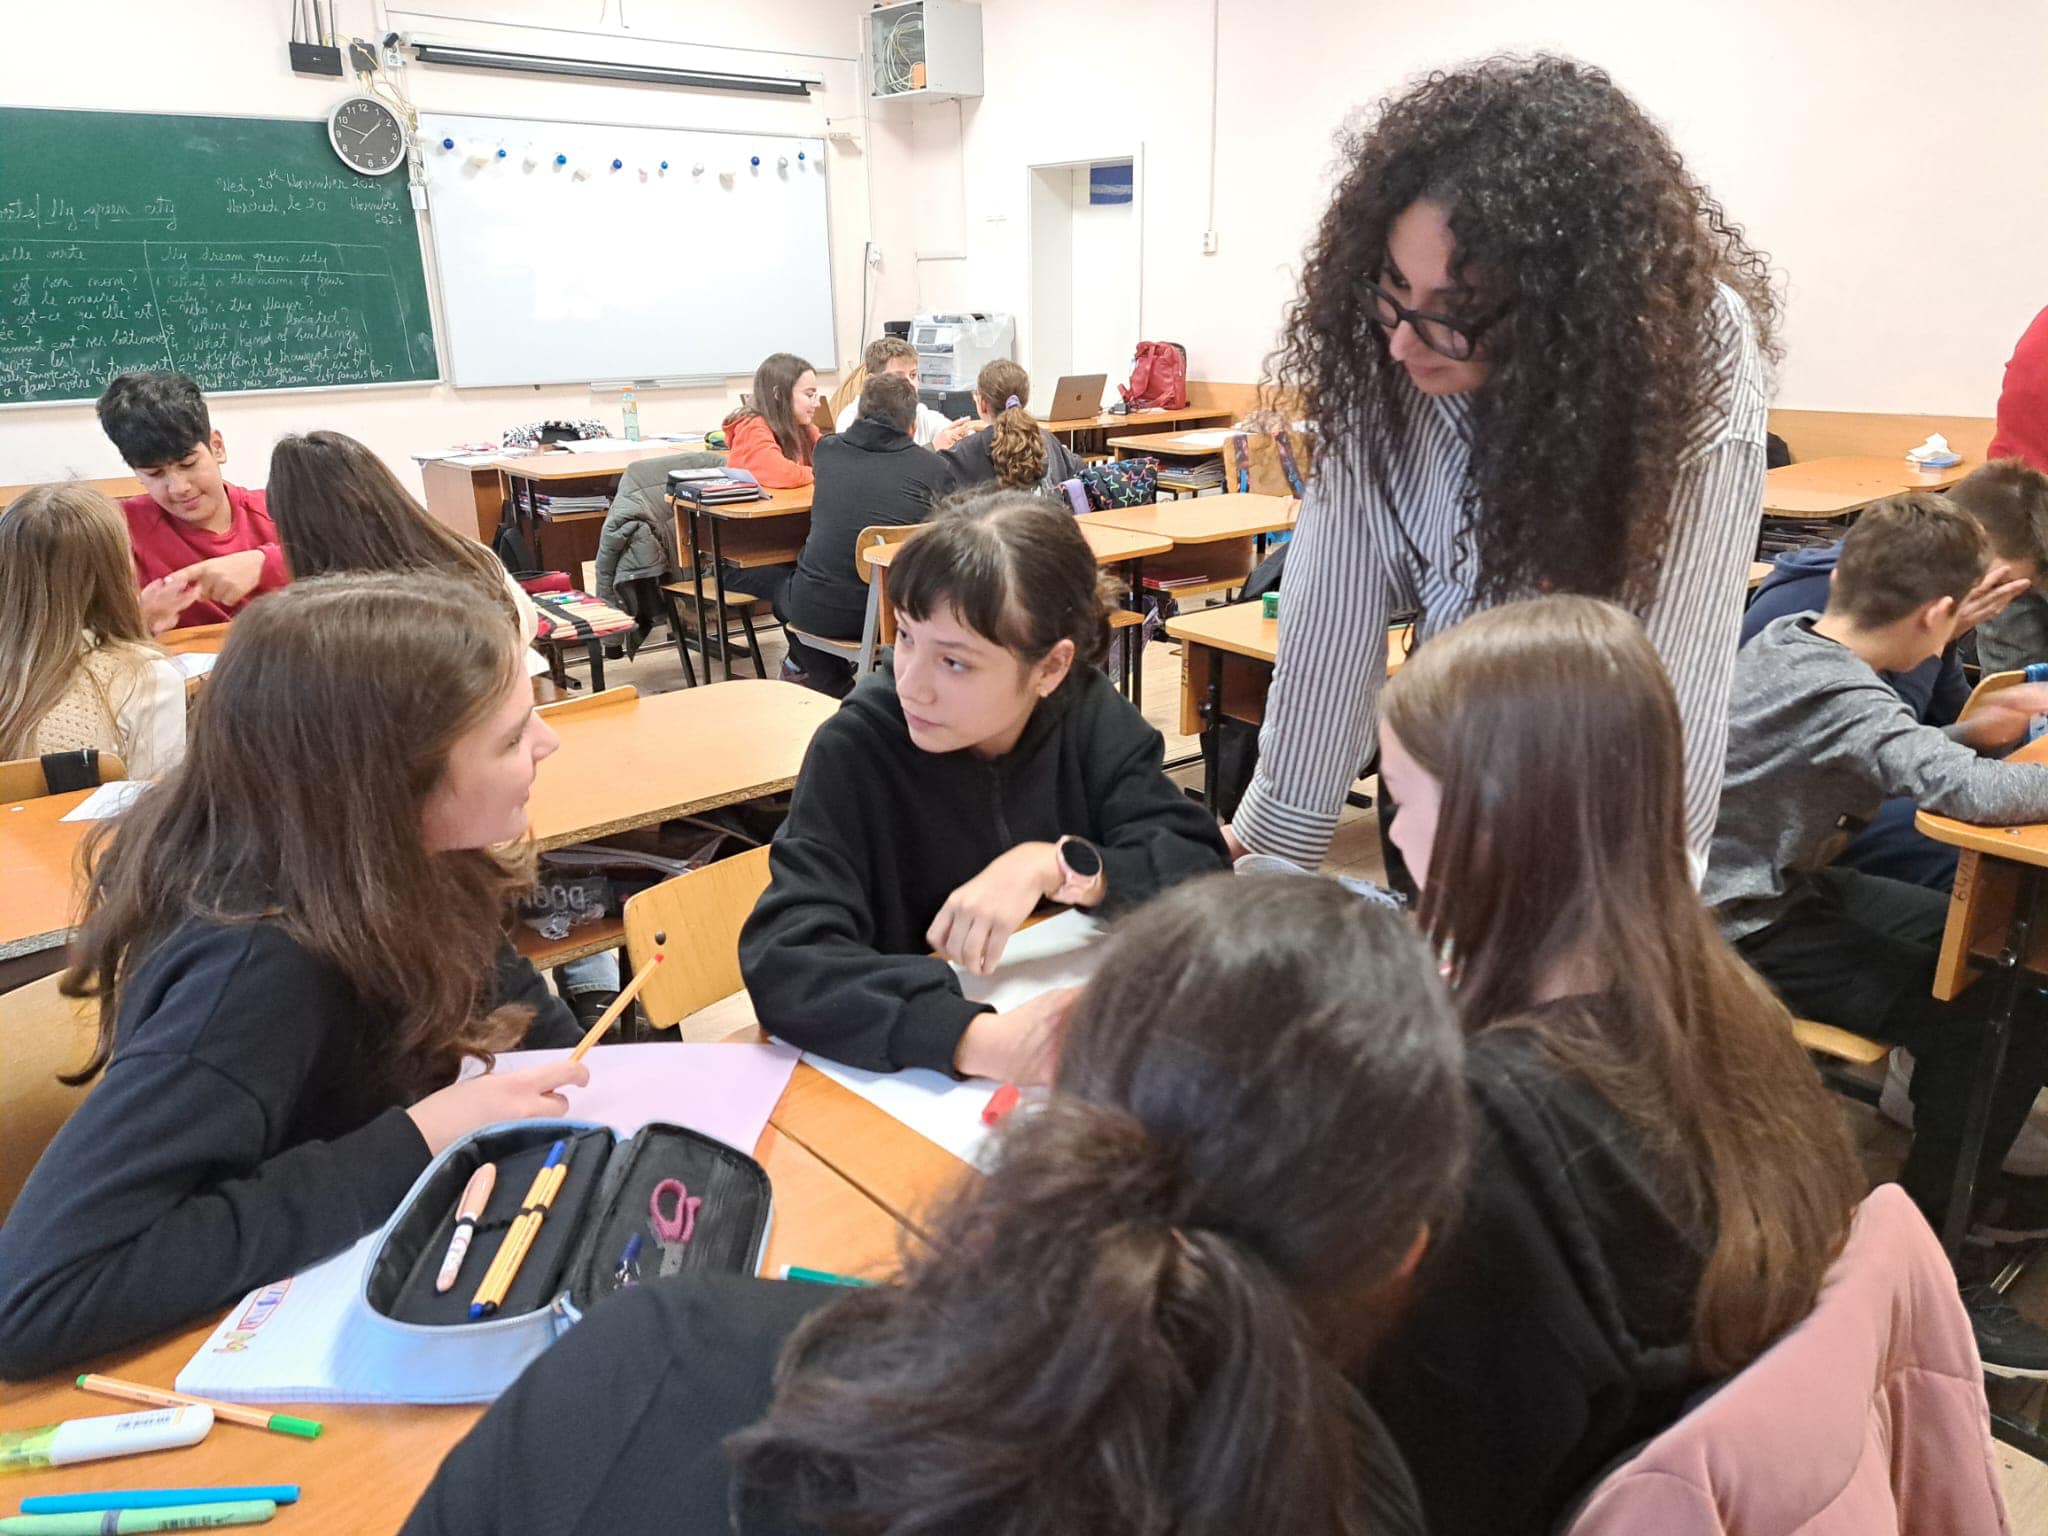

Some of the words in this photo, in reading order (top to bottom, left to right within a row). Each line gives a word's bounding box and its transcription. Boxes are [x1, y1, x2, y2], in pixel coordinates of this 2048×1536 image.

[346, 106, 356, 114] 11
[358, 103, 369, 112] 12
[375, 108, 380, 116] 1
[337, 116, 348, 124] 10
[385, 119, 392, 127] 2
[335, 130, 341, 138] 9
[392, 132, 398, 141] 3
[342, 144, 348, 152] 8
[390, 145, 395, 154] 4
[353, 154, 360, 162] 7
[381, 156, 387, 164] 5
[367, 159, 374, 168] 6
[50, 198, 78, 232] My
[145, 195, 178, 231] city
[0, 246, 33, 262] ille
[161, 246, 187, 271] My
[202, 247, 244, 262] dream
